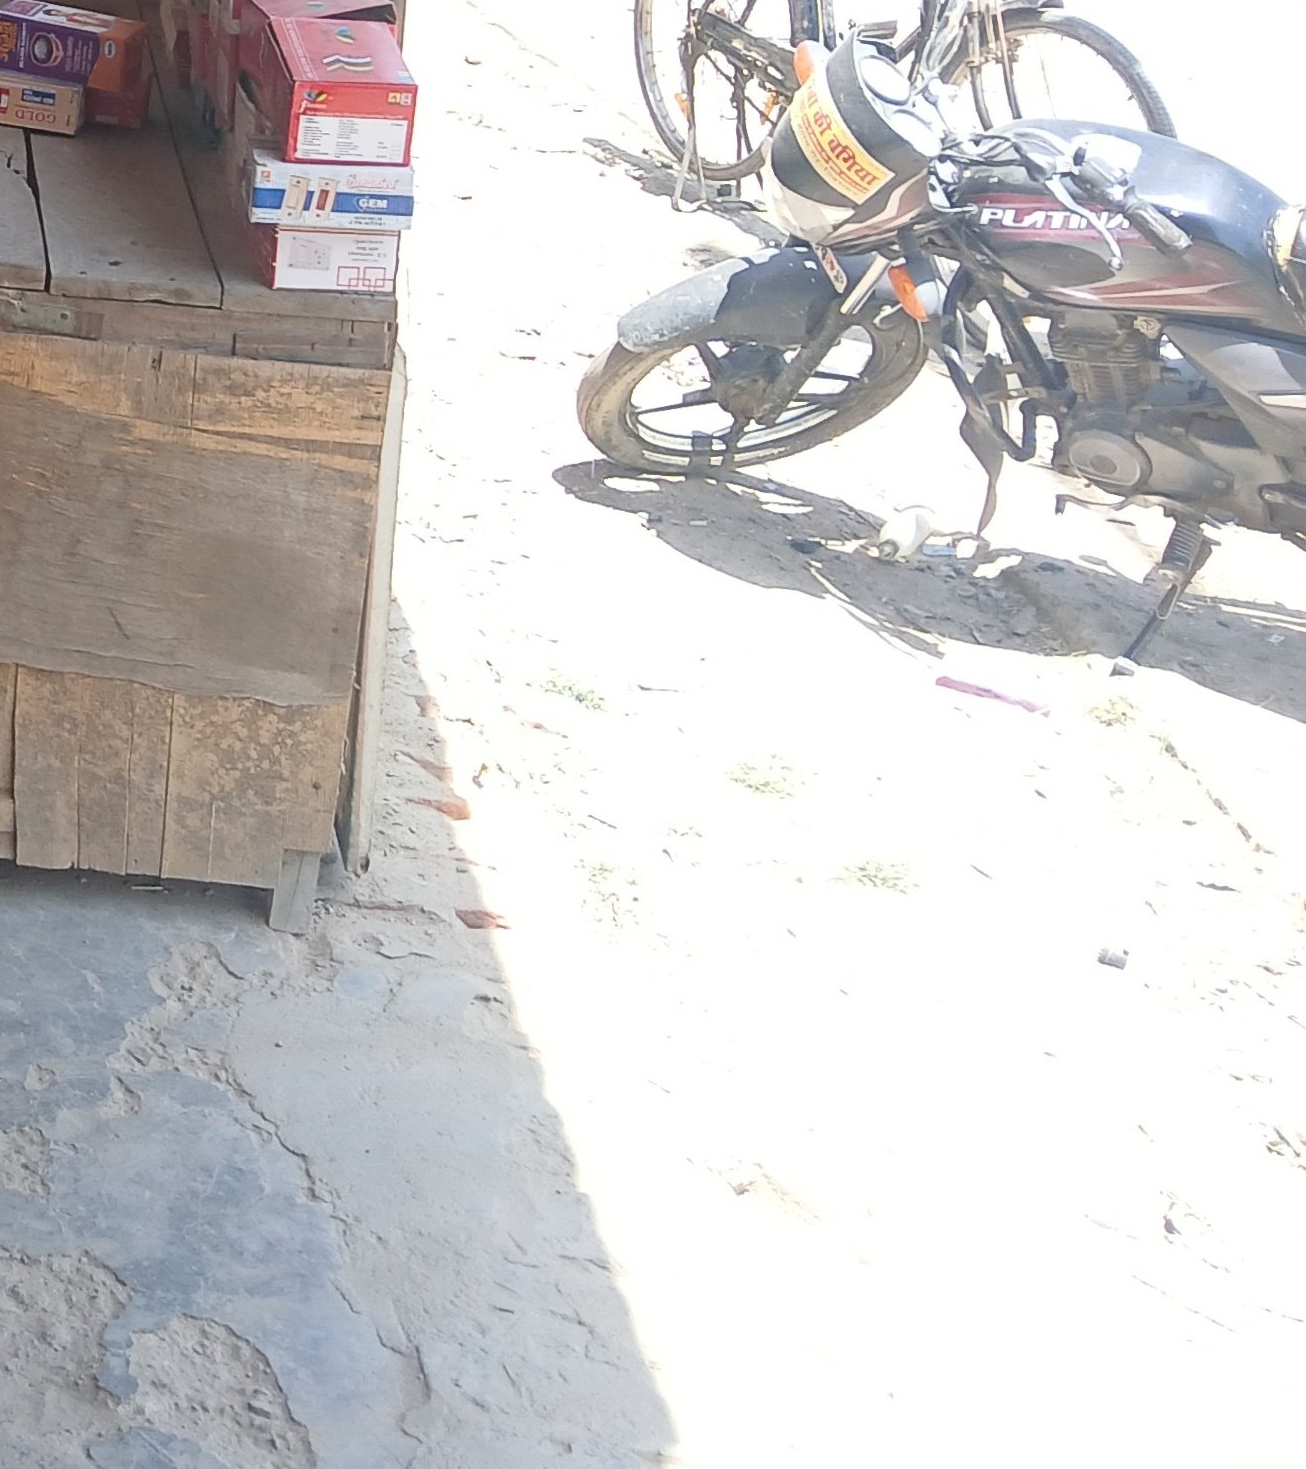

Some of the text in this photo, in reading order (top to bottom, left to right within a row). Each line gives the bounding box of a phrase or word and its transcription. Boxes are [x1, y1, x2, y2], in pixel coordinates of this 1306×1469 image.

[15, 107, 57, 124] GOLD
[813, 106, 832, 137] की
[359, 196, 389, 209] GEM
[979, 207, 1131, 230] PLATINA
